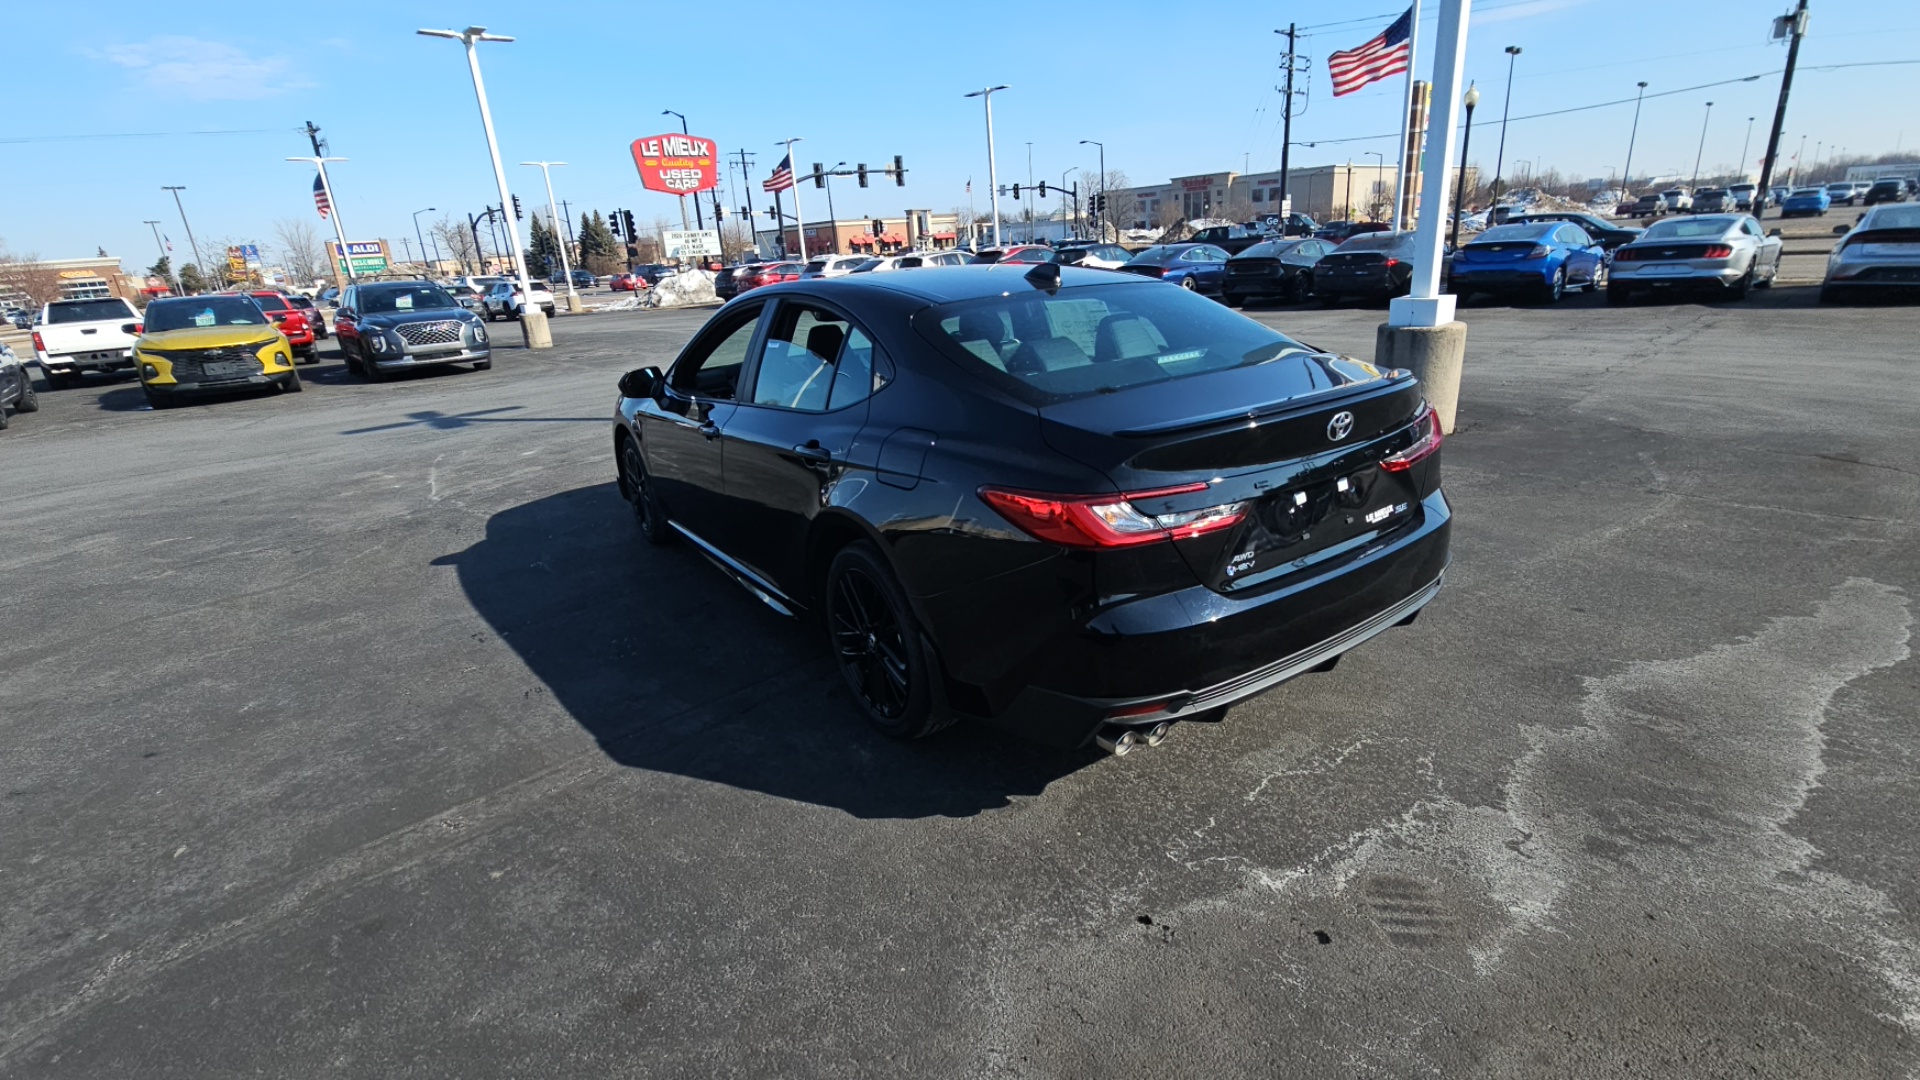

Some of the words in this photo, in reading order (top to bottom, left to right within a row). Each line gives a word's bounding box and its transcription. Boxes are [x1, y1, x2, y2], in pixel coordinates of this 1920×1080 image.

[641, 141, 659, 156] LE
[662, 137, 709, 156] MIEUX
[662, 158, 694, 168] Quality
[660, 169, 702, 179] USED
[666, 179, 699, 190] CARS
[352, 244, 379, 253] ALDI
[1231, 551, 1254, 563] AWD
